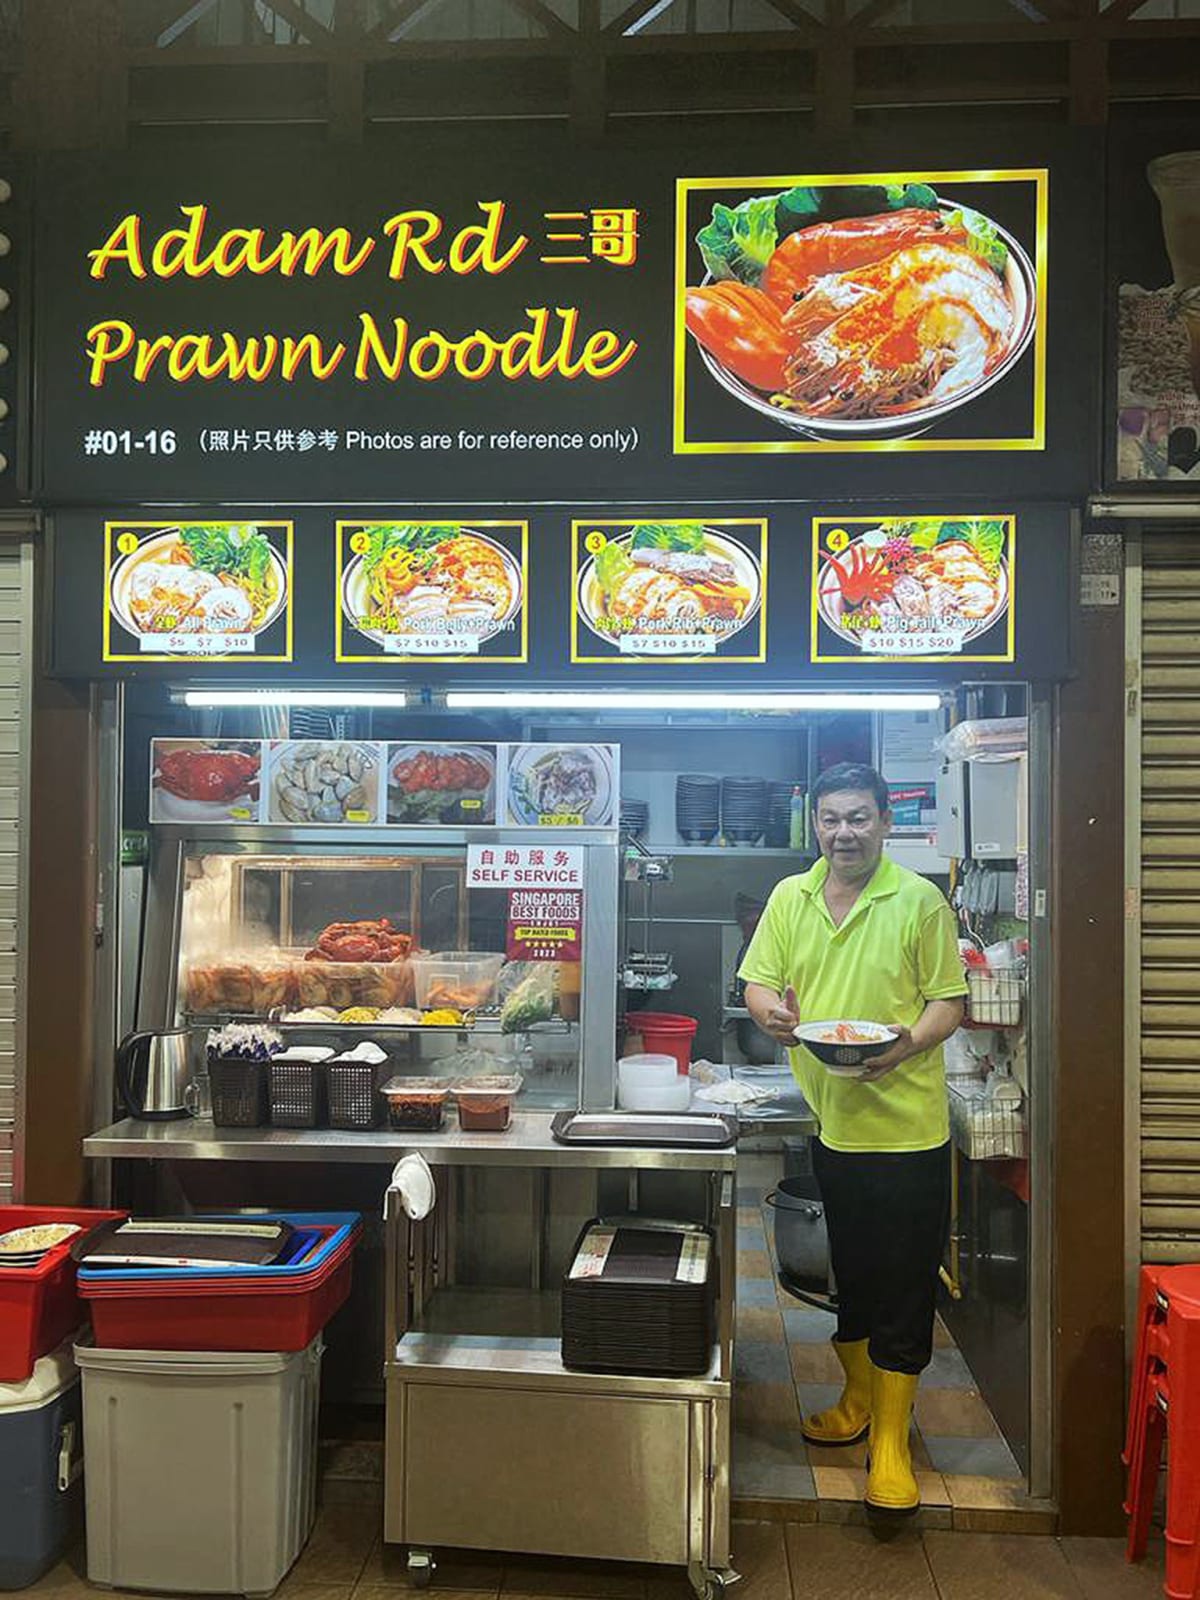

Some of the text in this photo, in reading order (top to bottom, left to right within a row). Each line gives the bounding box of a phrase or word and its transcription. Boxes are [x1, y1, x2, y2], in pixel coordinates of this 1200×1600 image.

[87, 200, 640, 280] Adam Rd 三哥
[85, 307, 638, 387] Prawn Noodle
[84, 429, 177, 455] #01-16
[345, 430, 415, 450] Photos
[420, 437, 452, 450] are
[458, 430, 485, 450] for
[489, 430, 584, 450] reference
[589, 427, 639, 452] only)
[124, 536, 131, 551] 1
[356, 536, 365, 550] 2
[591, 535, 601, 550] 3
[832, 533, 842, 547] 4
[224, 636, 249, 647] $10
[869, 638, 895, 648] $10
[899, 638, 924, 648] $15
[481, 849, 569, 867] 自助服务
[472, 869, 579, 882] SELF SERVICE
[511, 891, 581, 907] SINGAPORE
[512, 906, 578, 918] BEST FOODS
